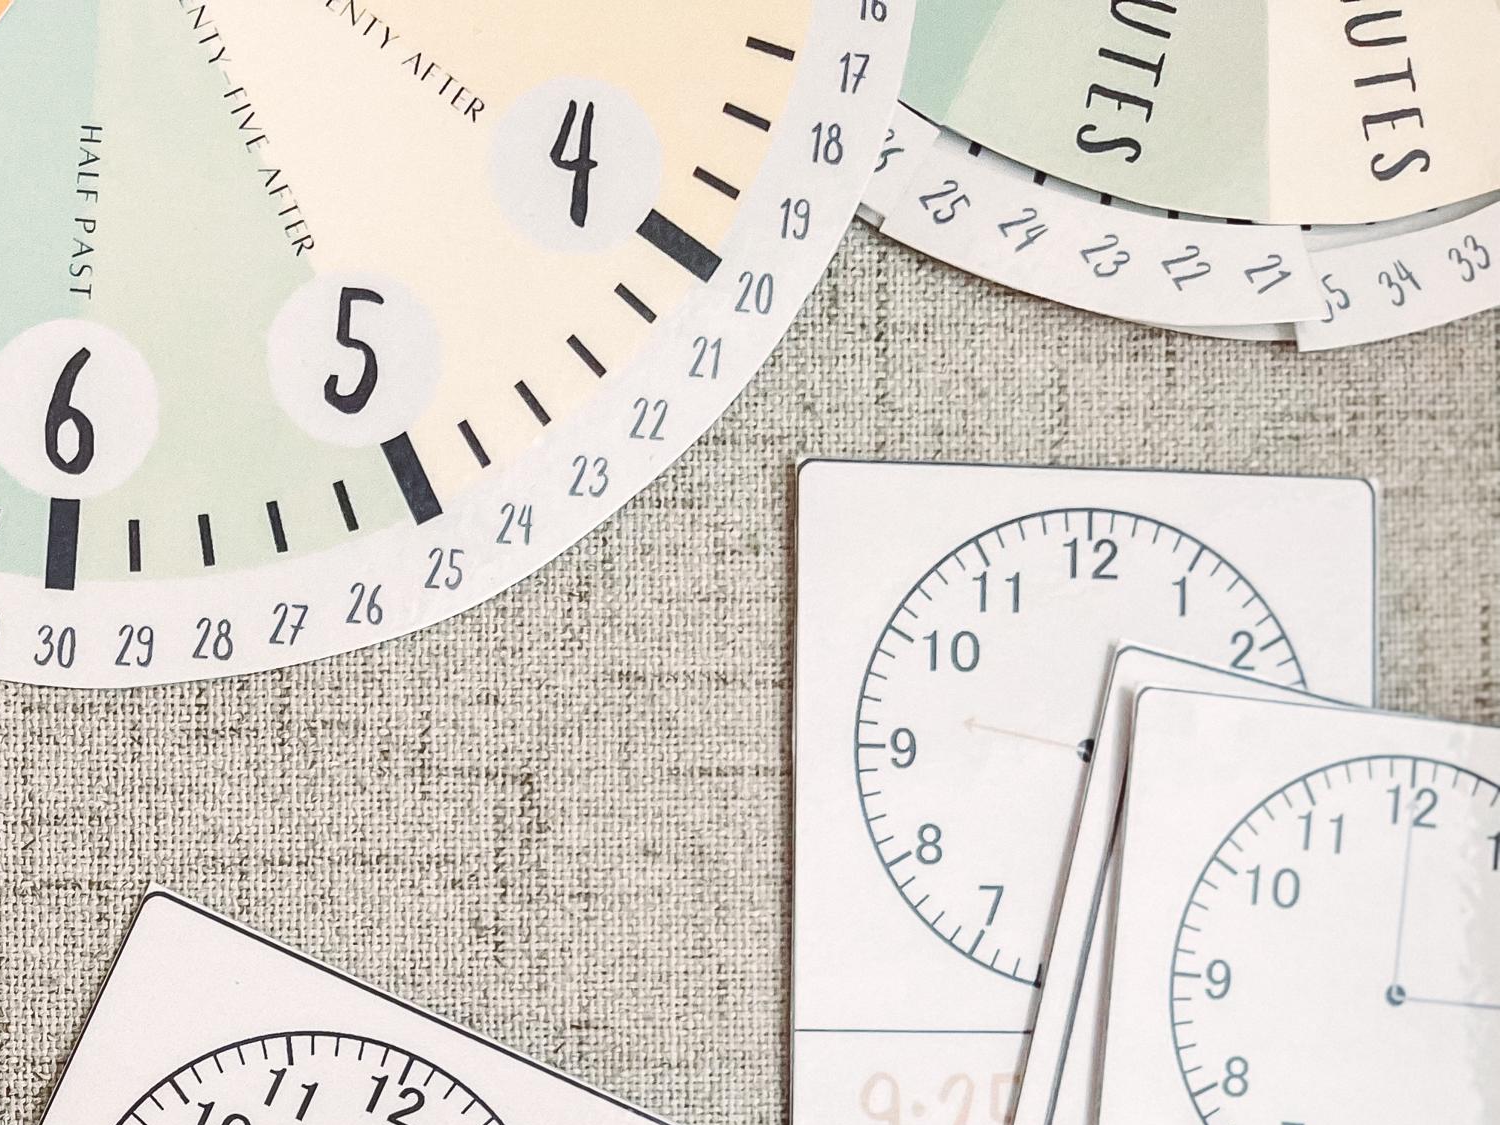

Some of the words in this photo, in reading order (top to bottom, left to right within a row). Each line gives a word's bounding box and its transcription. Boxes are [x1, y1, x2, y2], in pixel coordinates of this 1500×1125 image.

[401, 52, 485, 123] AFTER
[839, 52, 870, 94] 17
[179, 0, 270, 153] NTY-FIVE
[257, 168, 315, 257] AFTER
[810, 123, 844, 166] 18
[76, 125, 103, 203] HALF
[550, 100, 598, 227] 4
[780, 197, 810, 240] 19
[919, 180, 971, 224] 25
[997, 207, 1049, 253] 24
[69, 218, 97, 299] PAST
[1080, 234, 1131, 278] 23
[1161, 245, 1211, 292] 22
[1244, 254, 1292, 295] 21
[1449, 235, 1490, 282] 33
[734, 272, 774, 315] 20
[1378, 259, 1422, 306] 34
[323, 286, 385, 414] 5
[688, 337, 720, 380] 21
[45, 347, 95, 475] 6
[629, 399, 669, 441] 22
[568, 455, 609, 497] 23
[496, 503, 533, 545] 24
[424, 548, 464, 590] 25
[1063, 537, 1118, 579] 12
[346, 582, 383, 625] 26
[972, 571, 1020, 612] 11
[1172, 576, 1186, 616] 1
[192, 618, 233, 661] 28
[269, 603, 308, 645] 27
[34, 624, 76, 668] 30
[115, 624, 154, 668] 29
[922, 630, 980, 672] 10
[1229, 631, 1255, 671] 2
[890, 727, 917, 768] 9
[1386, 785, 1438, 828] 12
[915, 823, 942, 865] 8
[1297, 810, 1345, 854] 11
[979, 884, 1005, 925] 7
[1246, 864, 1300, 908] 10
[1205, 960, 1232, 999] 9
[264, 1068, 319, 1121] 11
[1222, 1056, 1249, 1097] 8
